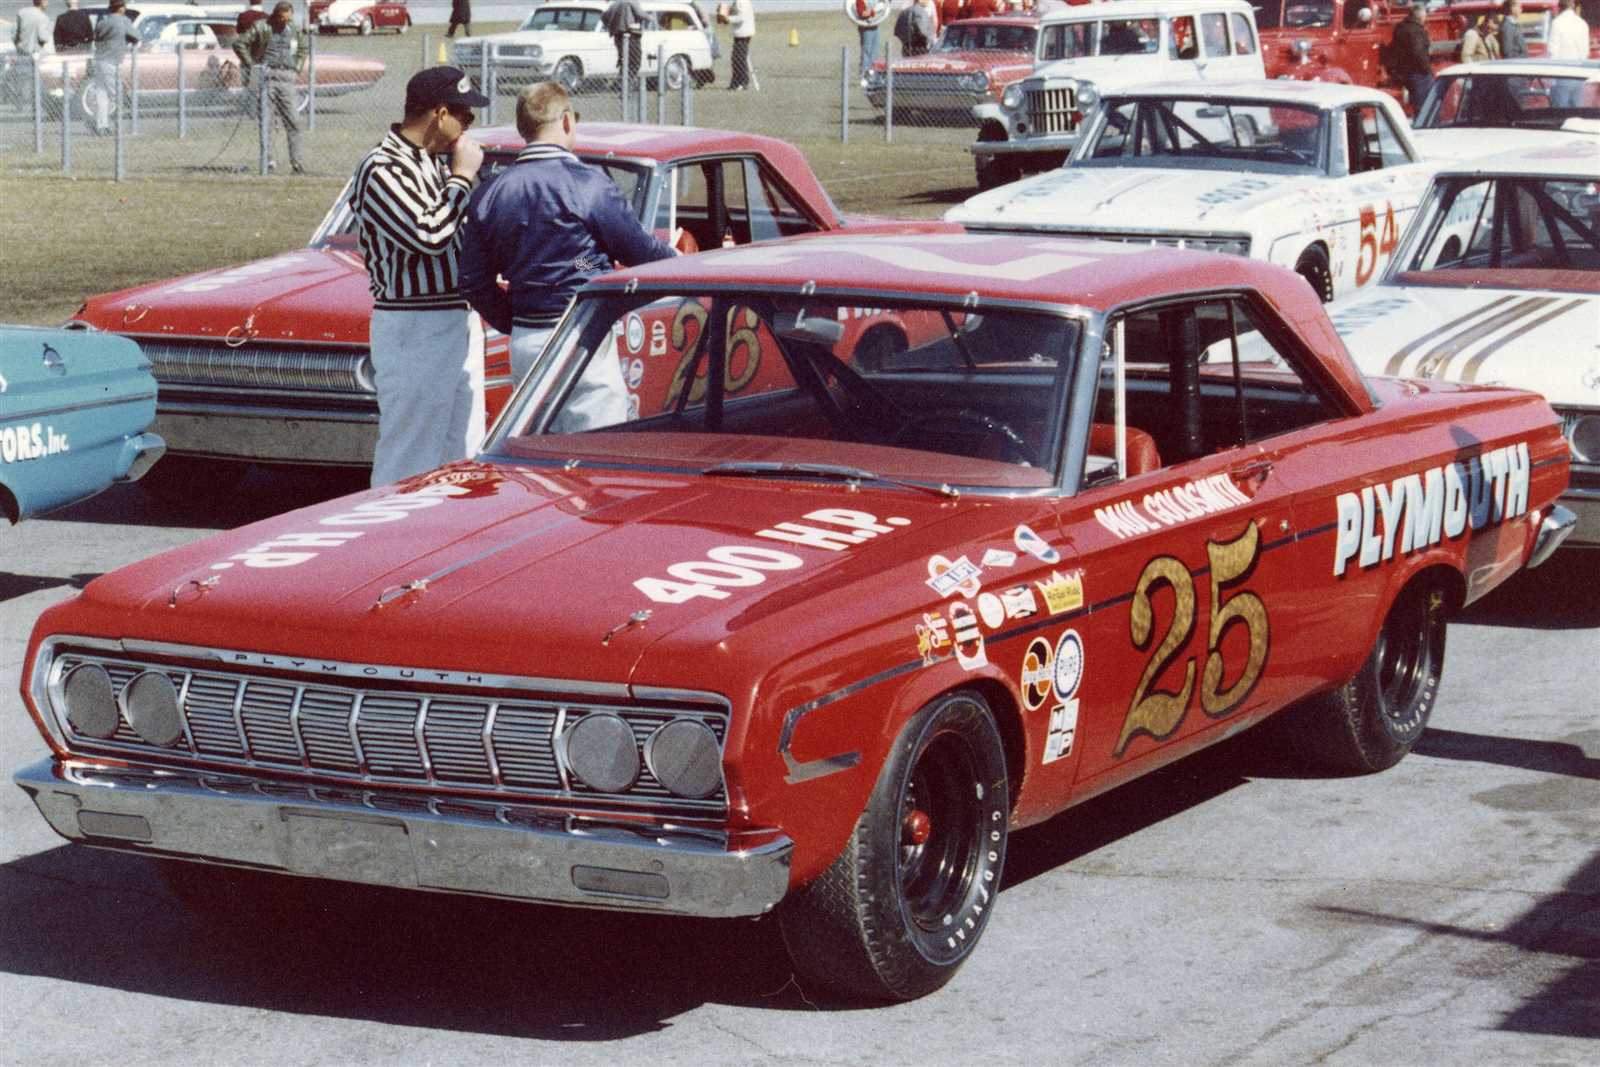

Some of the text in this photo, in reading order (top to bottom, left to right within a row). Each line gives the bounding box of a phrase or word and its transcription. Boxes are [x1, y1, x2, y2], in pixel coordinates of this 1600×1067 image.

[1355, 200, 1400, 288] 54
[663, 302, 762, 412] 26
[47, 426, 69, 454] Inc.
[1094, 473, 1252, 539] PAUL GOLDSMITH
[1333, 442, 1530, 577] PLYMOUTH
[632, 508, 912, 604] 400 H.P.
[235, 653, 482, 684] PLYMOUTH
[1112, 519, 1271, 760] 25
